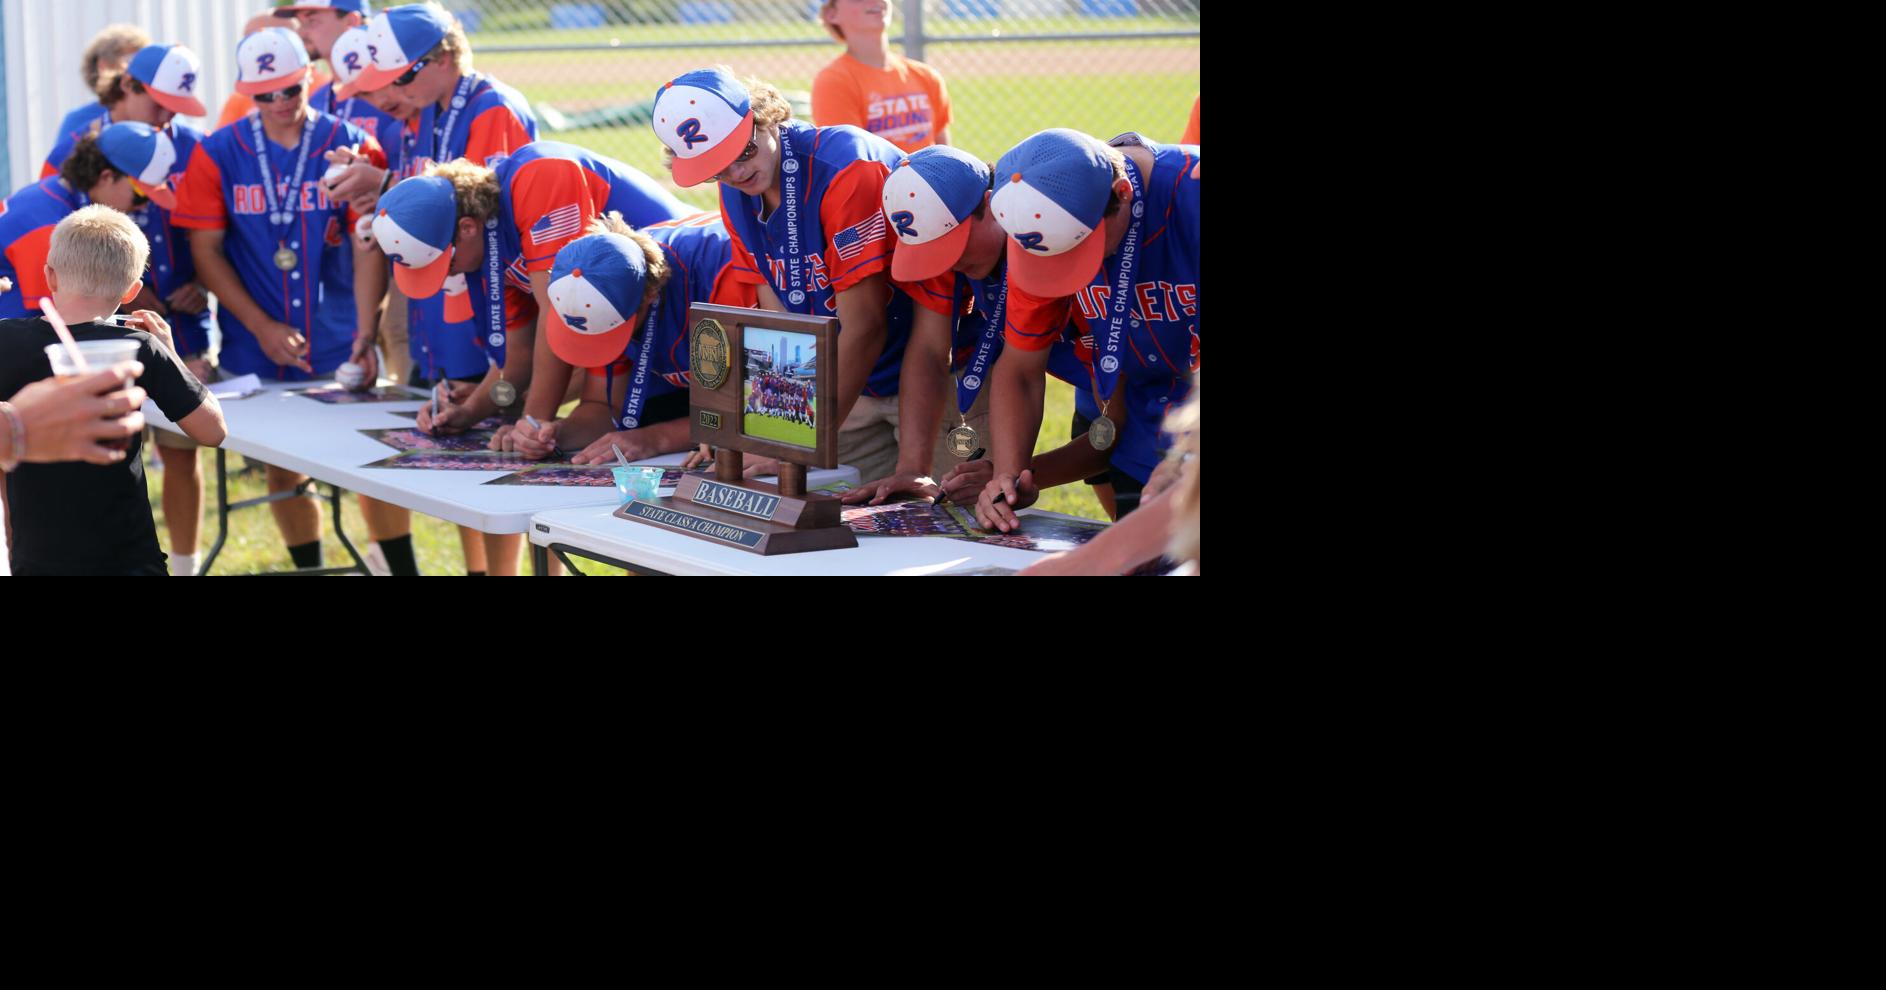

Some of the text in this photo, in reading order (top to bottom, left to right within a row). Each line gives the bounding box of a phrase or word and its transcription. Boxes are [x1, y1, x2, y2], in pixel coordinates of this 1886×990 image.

[257, 53, 275, 75] R
[343, 52, 362, 74] R
[178, 72, 196, 92] R
[867, 94, 929, 119] STATE
[676, 117, 709, 150] R
[779, 127, 793, 157] STATE
[786, 176, 800, 287] STATE CHAMPIONSHIPS
[891, 210, 918, 237] R
[1014, 231, 1049, 252] R
[488, 230, 501, 331] STATE CHAMPIONSHIPS
[1107, 221, 1140, 352] STATE CHAMPIONSHIPS
[973, 342, 991, 373] STATE
[627, 388, 642, 415] STATE
[701, 414, 719, 427] 2022
[695, 482, 775, 518] BASEBALL
[640, 506, 667, 521] STATE
[664, 512, 694, 528] CLASS
[697, 520, 746, 541] CHAMPION
